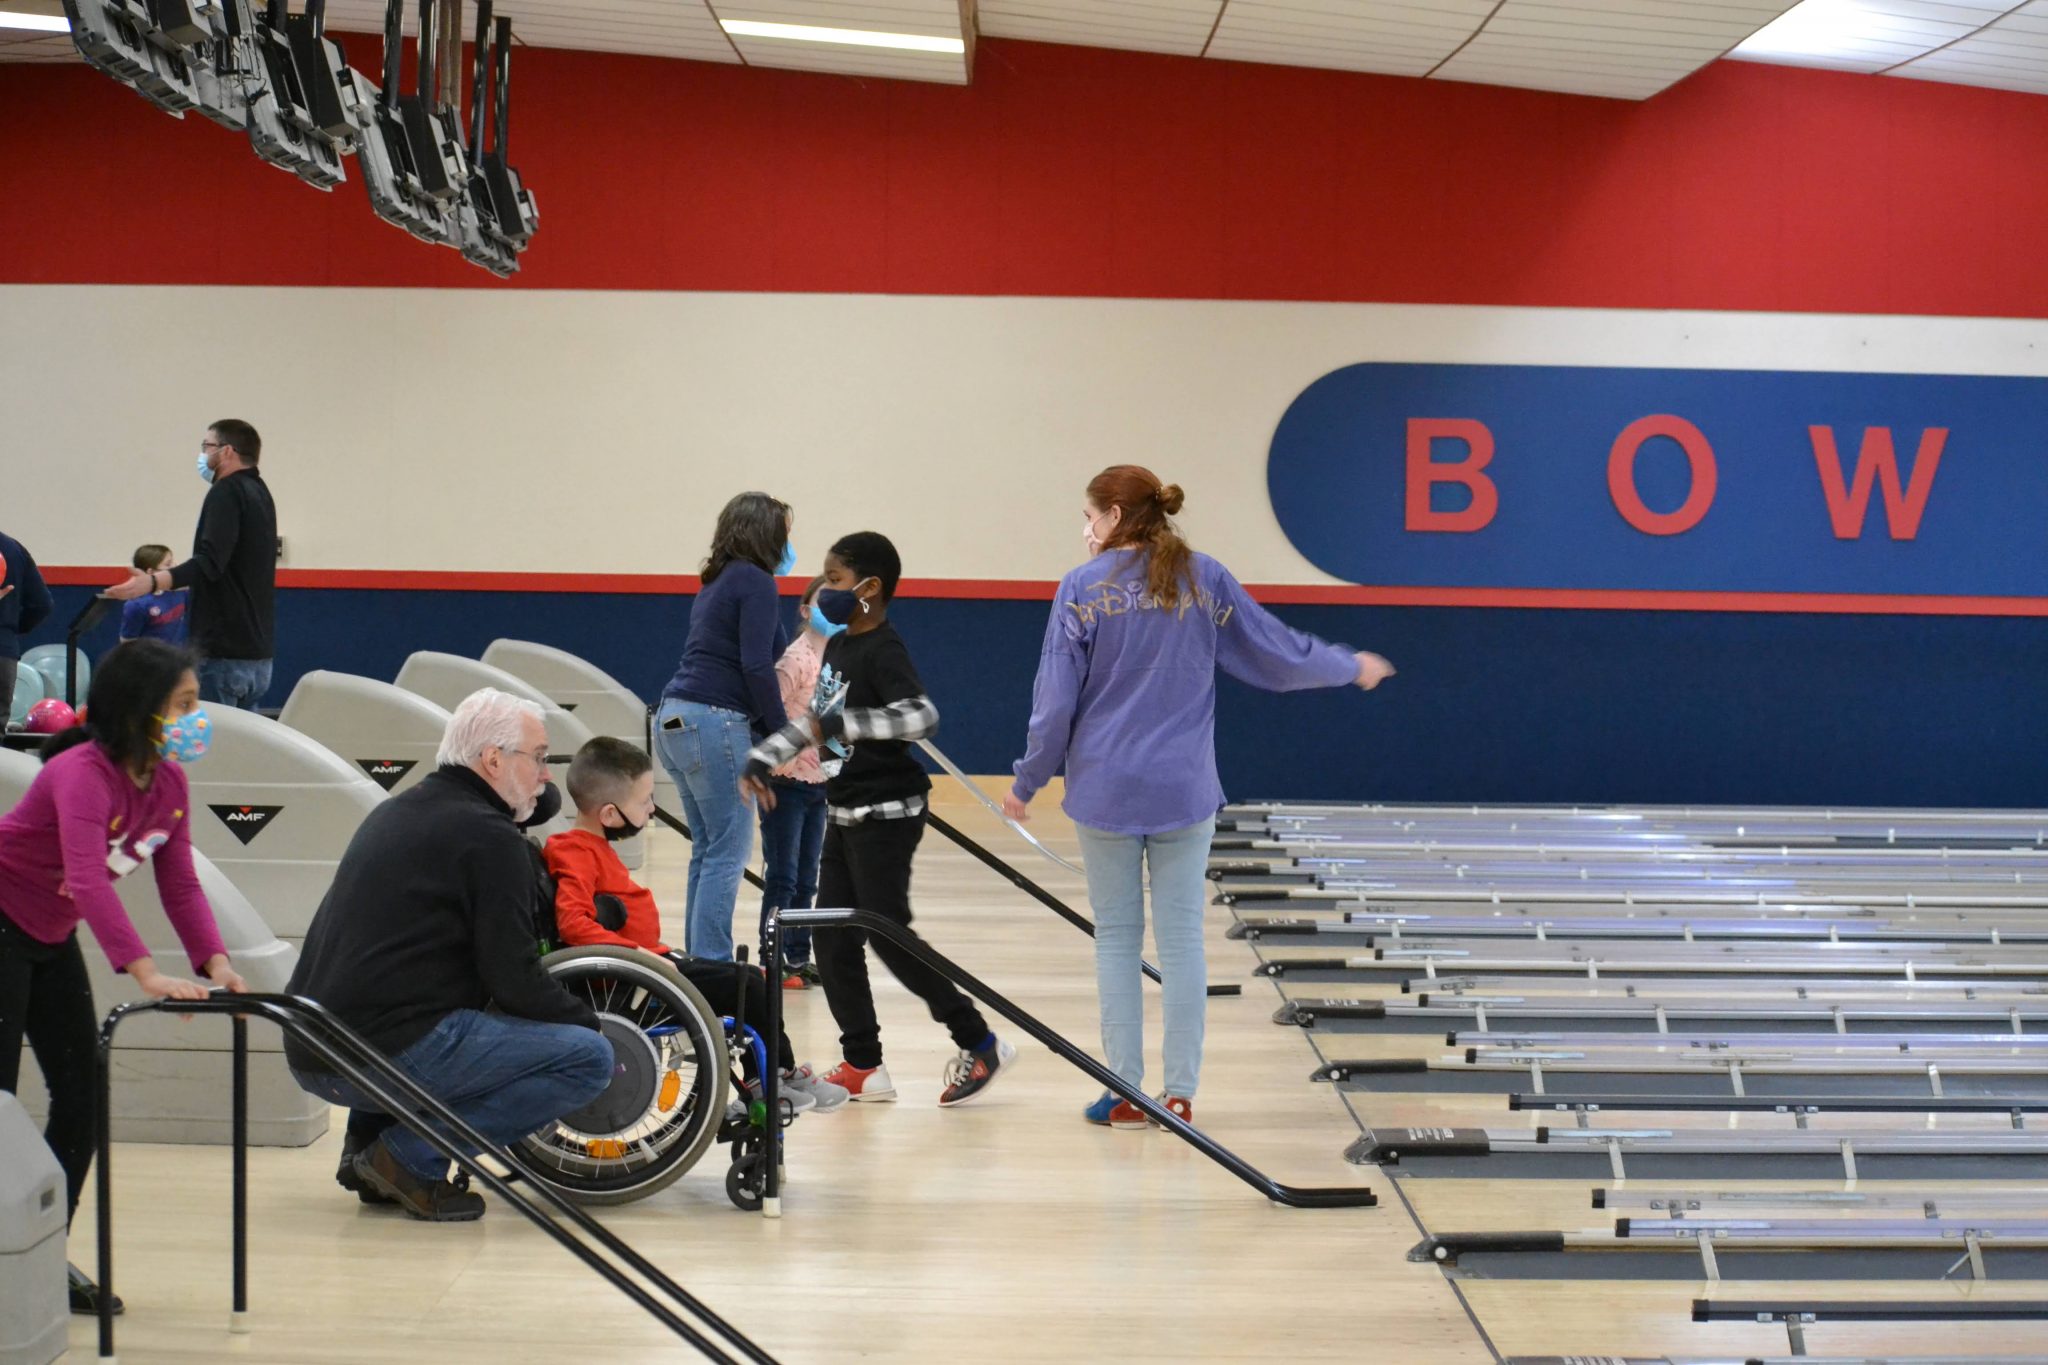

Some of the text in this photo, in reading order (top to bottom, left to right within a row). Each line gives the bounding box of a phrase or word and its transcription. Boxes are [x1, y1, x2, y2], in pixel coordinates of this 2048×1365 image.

[1404, 413, 1949, 540] BOW
[370, 766, 404, 774] AMF
[226, 812, 266, 822] AMF
